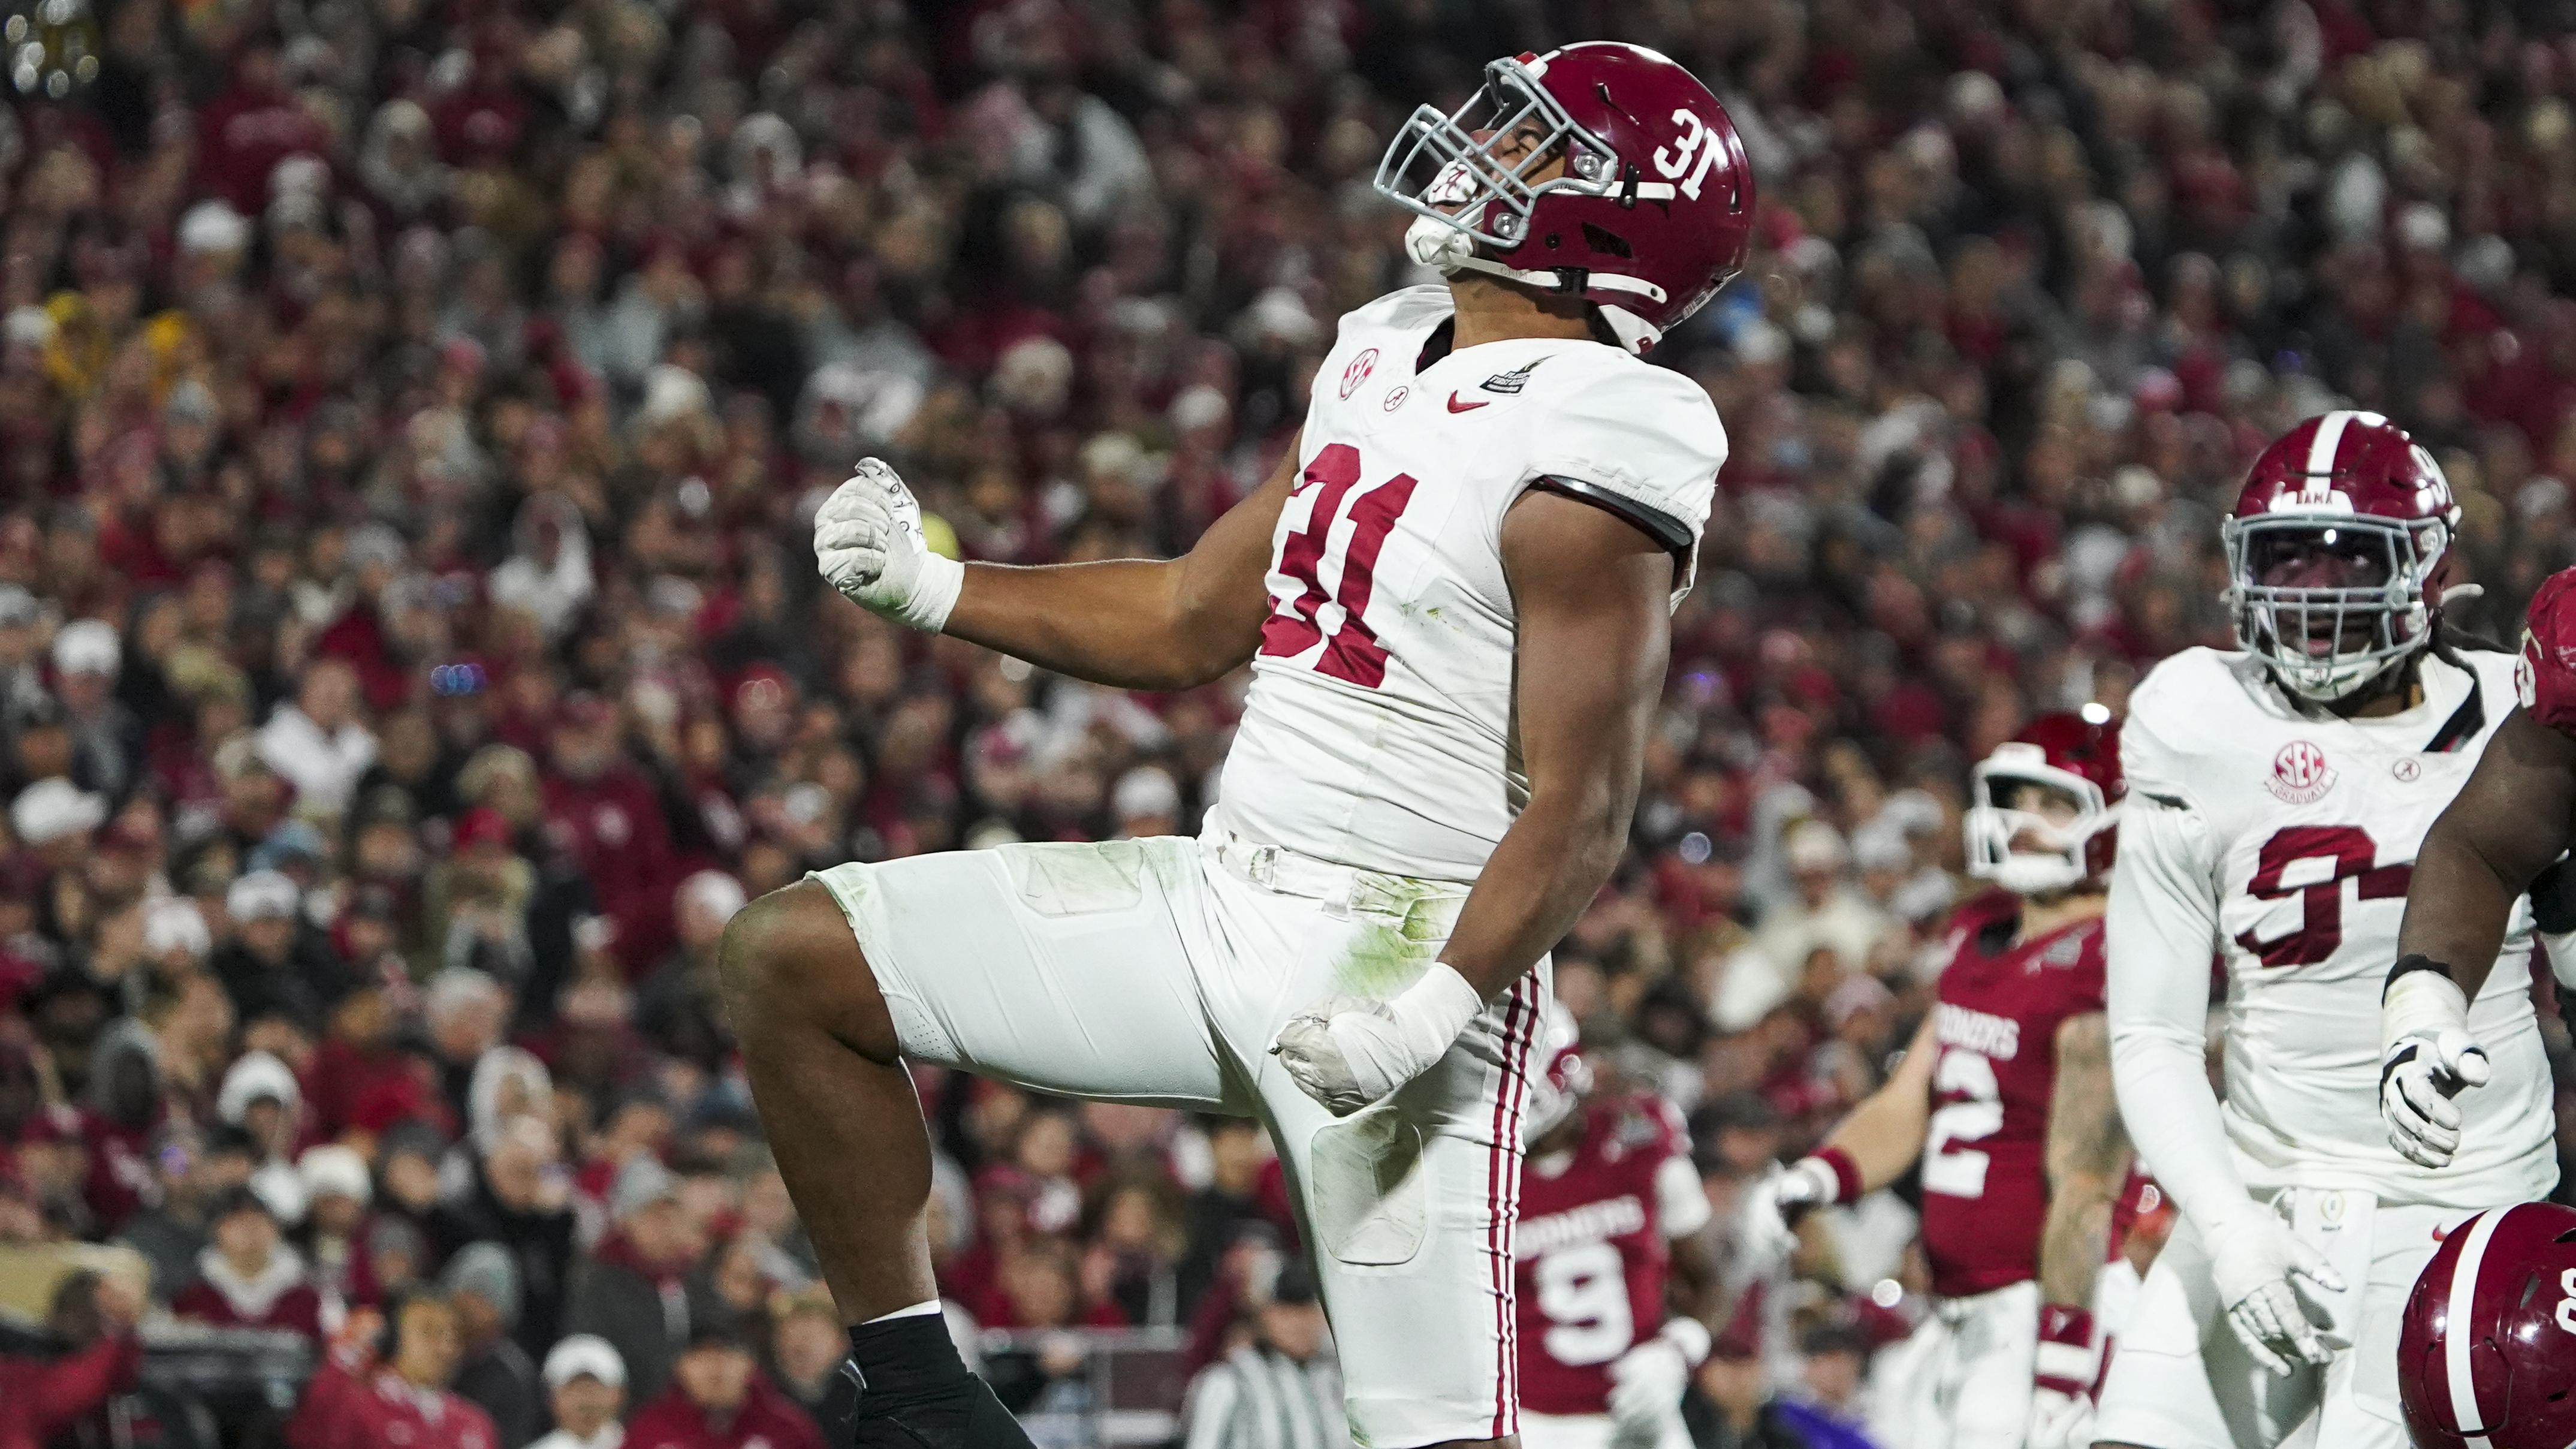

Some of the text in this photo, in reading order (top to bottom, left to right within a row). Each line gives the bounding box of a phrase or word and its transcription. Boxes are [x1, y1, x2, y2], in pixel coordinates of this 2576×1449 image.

[1653, 109, 1720, 201] 31
[1259, 443, 1419, 688] 31
[2275, 781, 2328, 804] GRADUATE
[2276, 742, 2324, 788] SEC
[2234, 825, 2415, 968] 9
[1922, 1049, 2004, 1198] 2
[1536, 1242, 1635, 1366] 9
